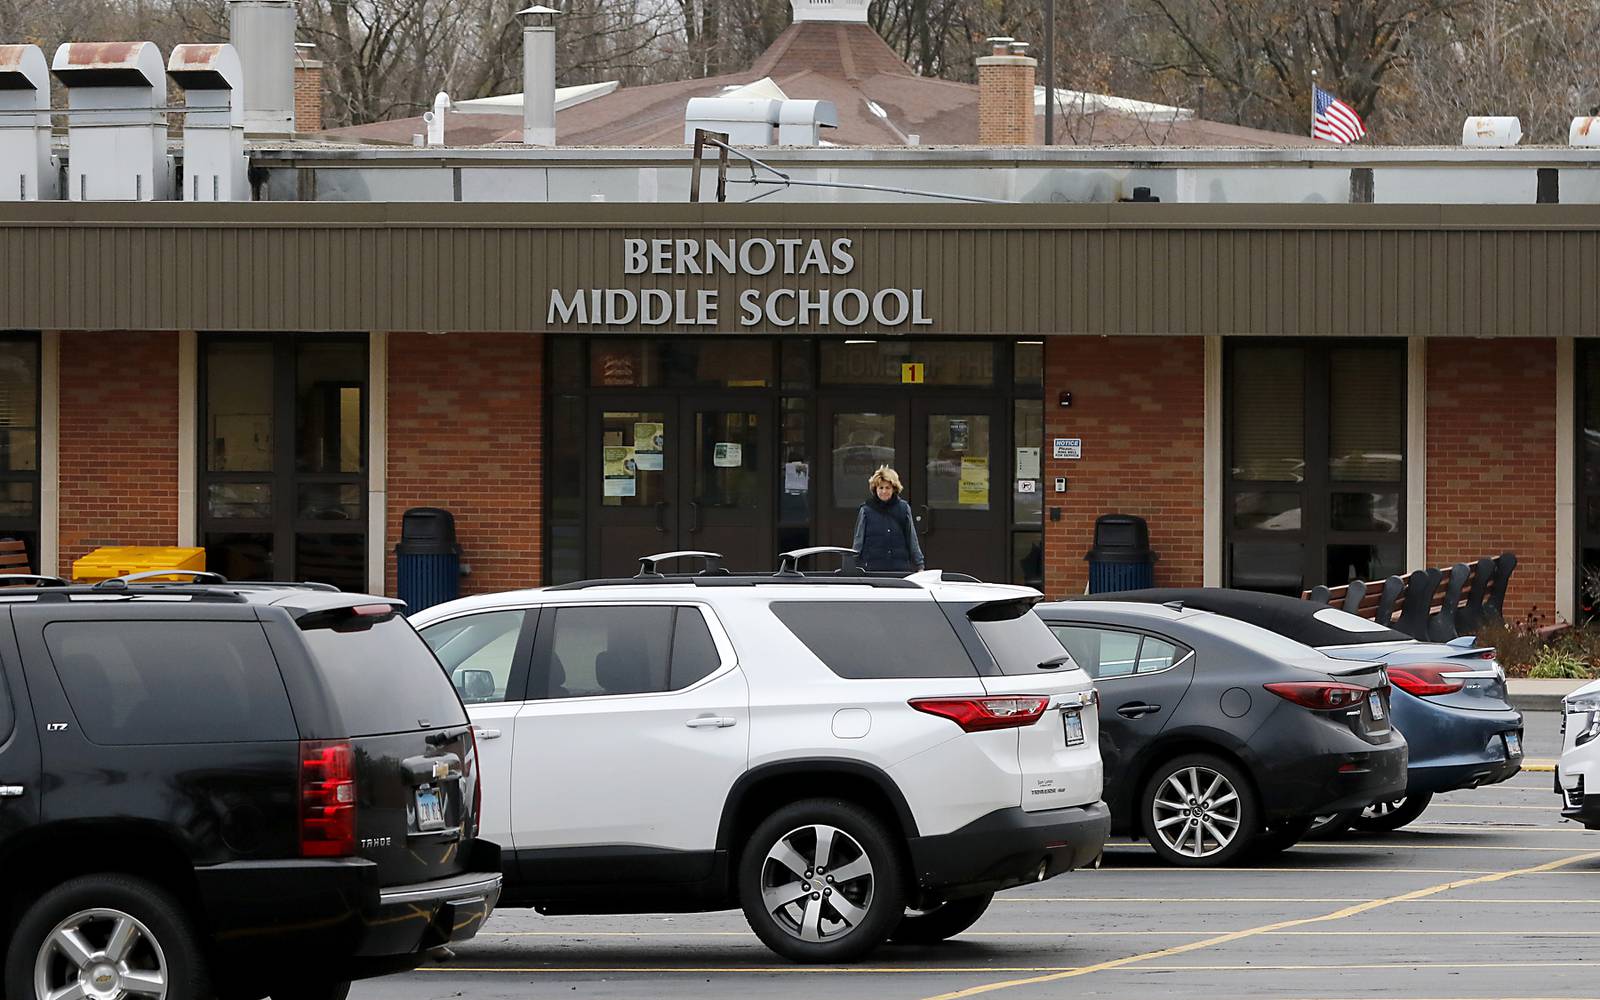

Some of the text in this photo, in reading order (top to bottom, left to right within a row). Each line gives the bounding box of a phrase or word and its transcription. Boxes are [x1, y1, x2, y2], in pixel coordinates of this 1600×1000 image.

[624, 238, 855, 276] BERNOTAS
[546, 288, 933, 327] MIDDLE SCHOOL
[908, 364, 915, 382] 1
[47, 721, 69, 731] LTZ
[361, 837, 391, 849] TAHOE
